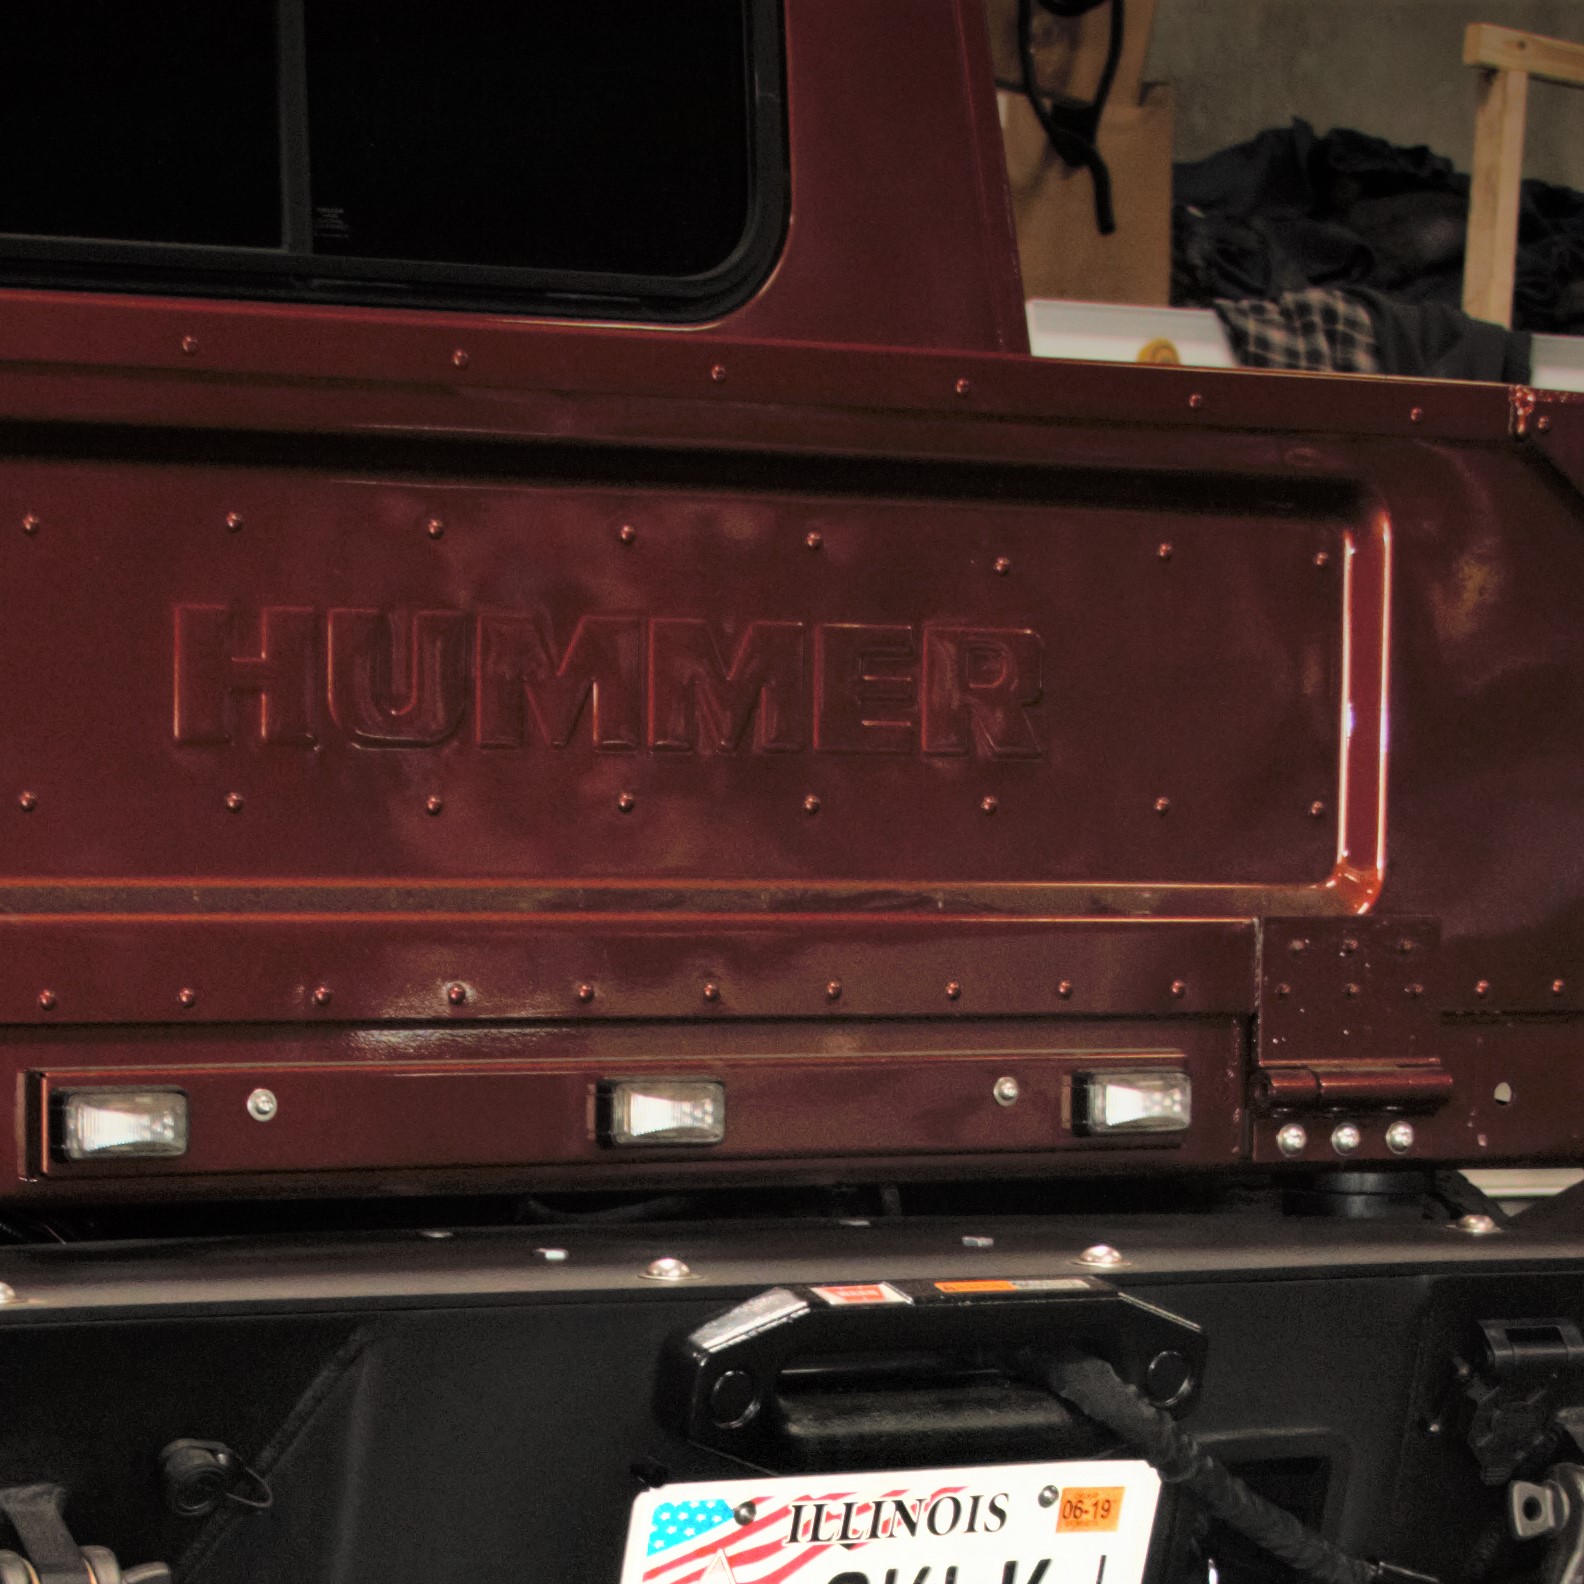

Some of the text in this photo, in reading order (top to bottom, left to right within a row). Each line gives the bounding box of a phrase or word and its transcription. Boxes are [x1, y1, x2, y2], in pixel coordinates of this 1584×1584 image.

[171, 604, 1048, 760] HUMMER
[785, 1492, 1010, 1545] ILLINOIS
[1063, 1499, 1111, 1520] 06-19
